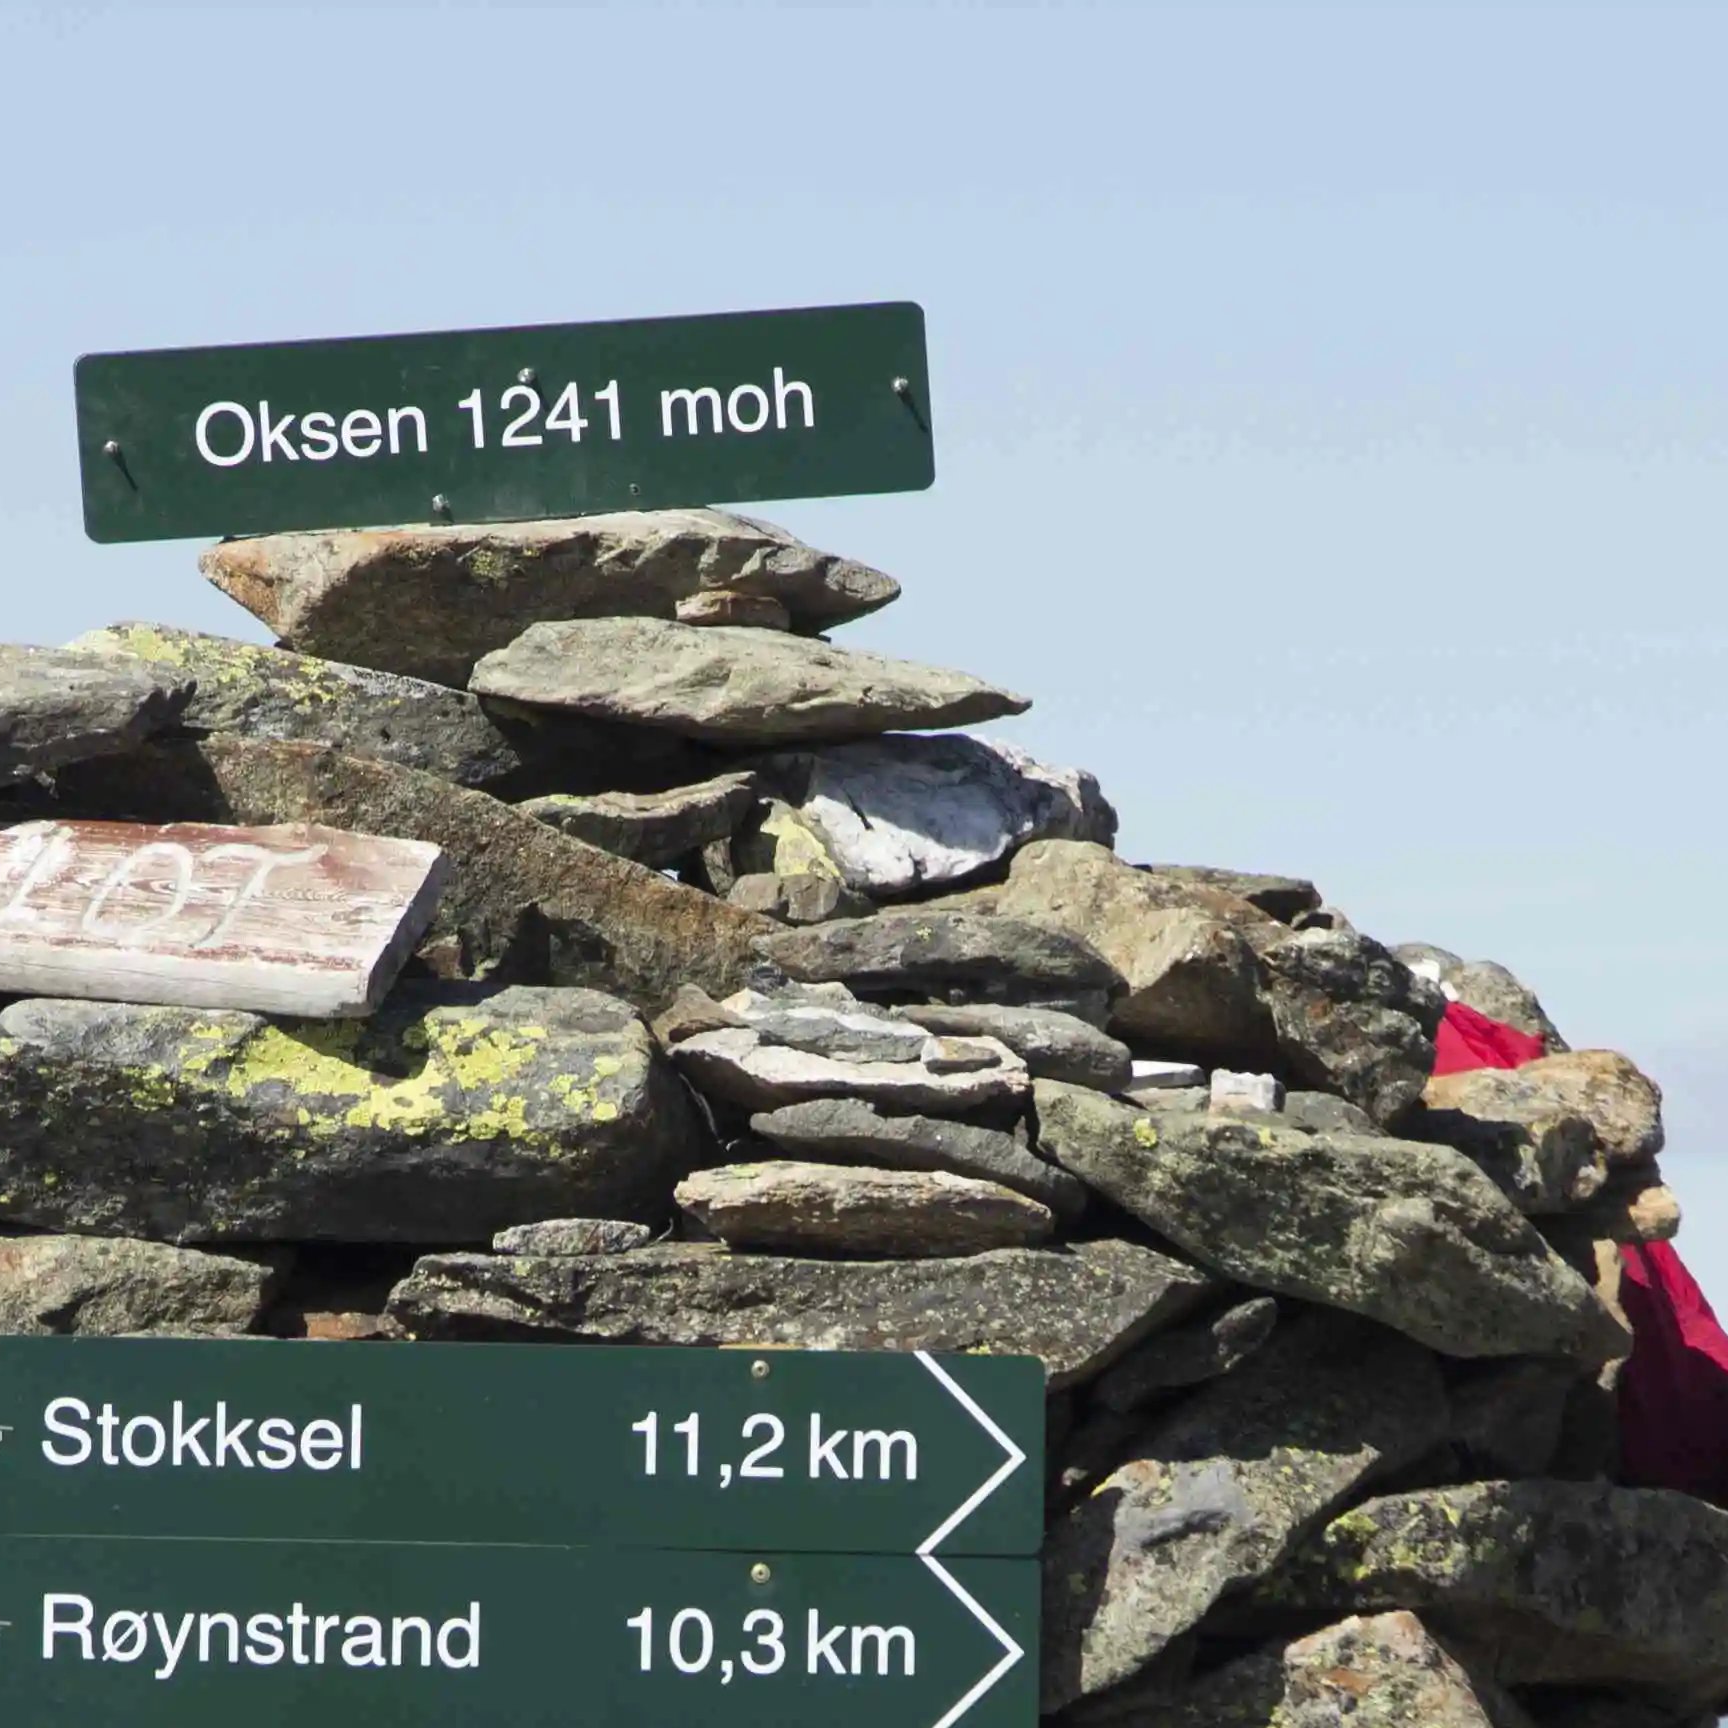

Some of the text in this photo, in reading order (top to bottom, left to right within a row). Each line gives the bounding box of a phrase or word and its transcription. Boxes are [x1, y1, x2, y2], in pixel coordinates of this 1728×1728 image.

[196, 367, 815, 467] Oksen 1241 moh
[41, 1396, 917, 1488] Stokksel 11,2 km
[42, 1593, 915, 1685] Røynstrand 10,3 km
